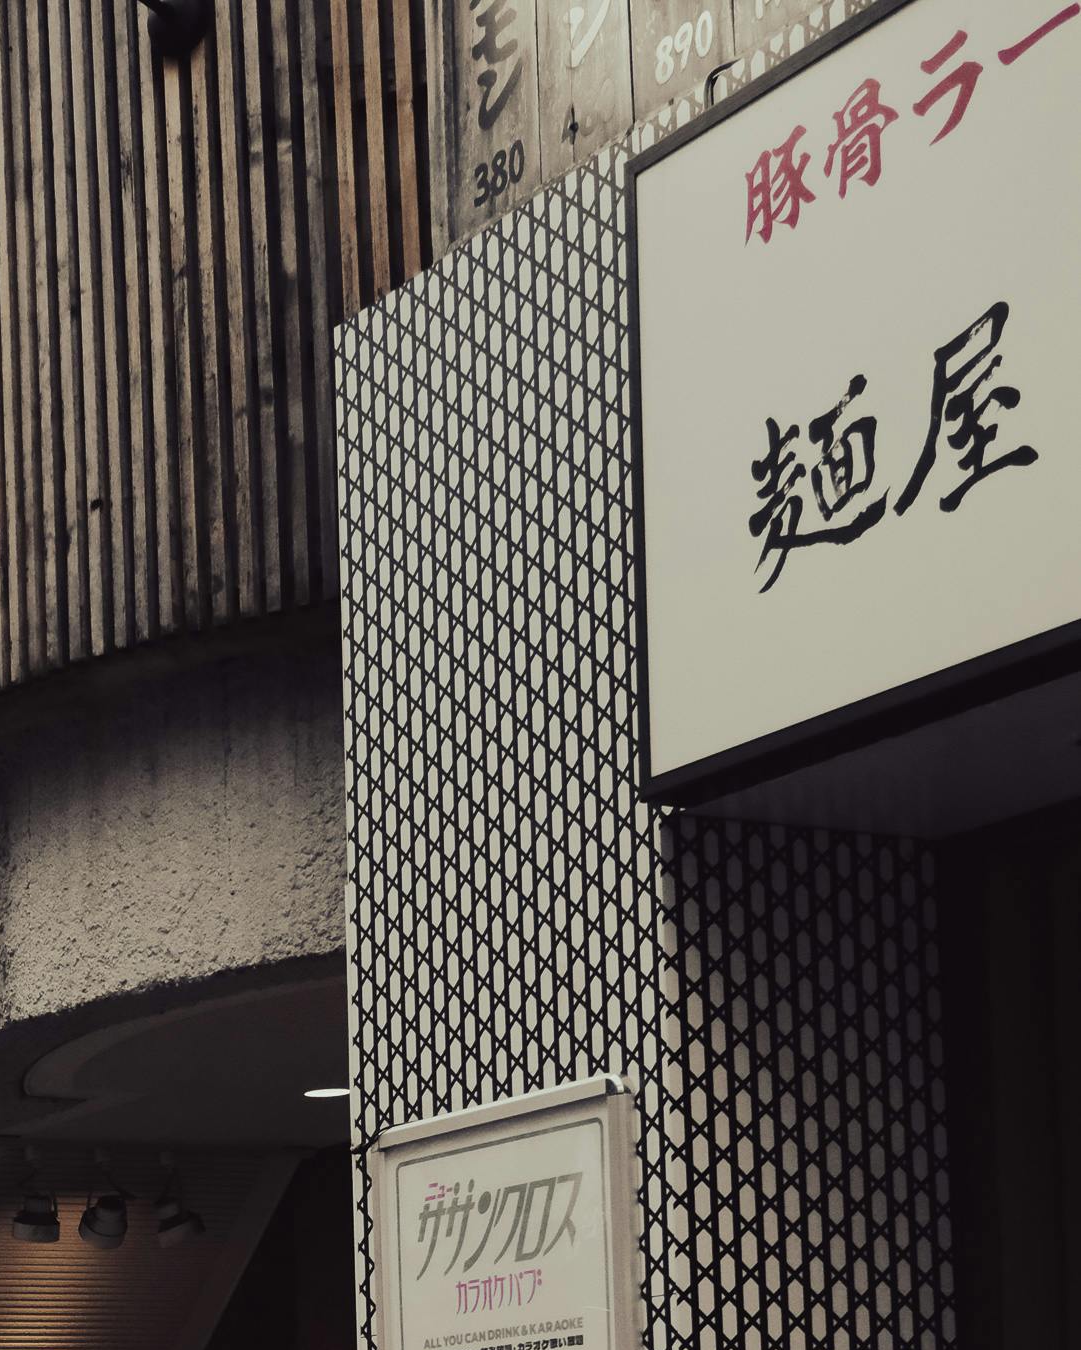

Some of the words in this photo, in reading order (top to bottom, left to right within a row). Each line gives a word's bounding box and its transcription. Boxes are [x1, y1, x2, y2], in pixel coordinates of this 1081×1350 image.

[470, 0, 523, 130] モン
[654, 10, 713, 85] 890
[474, 139, 524, 208] 380
[424, 1338, 442, 1349] ALL
[443, 1335, 463, 1347] YOU
[464, 1331, 485, 1344] CAN
[487, 1326, 520, 1341] DRINK
[530, 1316, 584, 1334] KARAOKE
